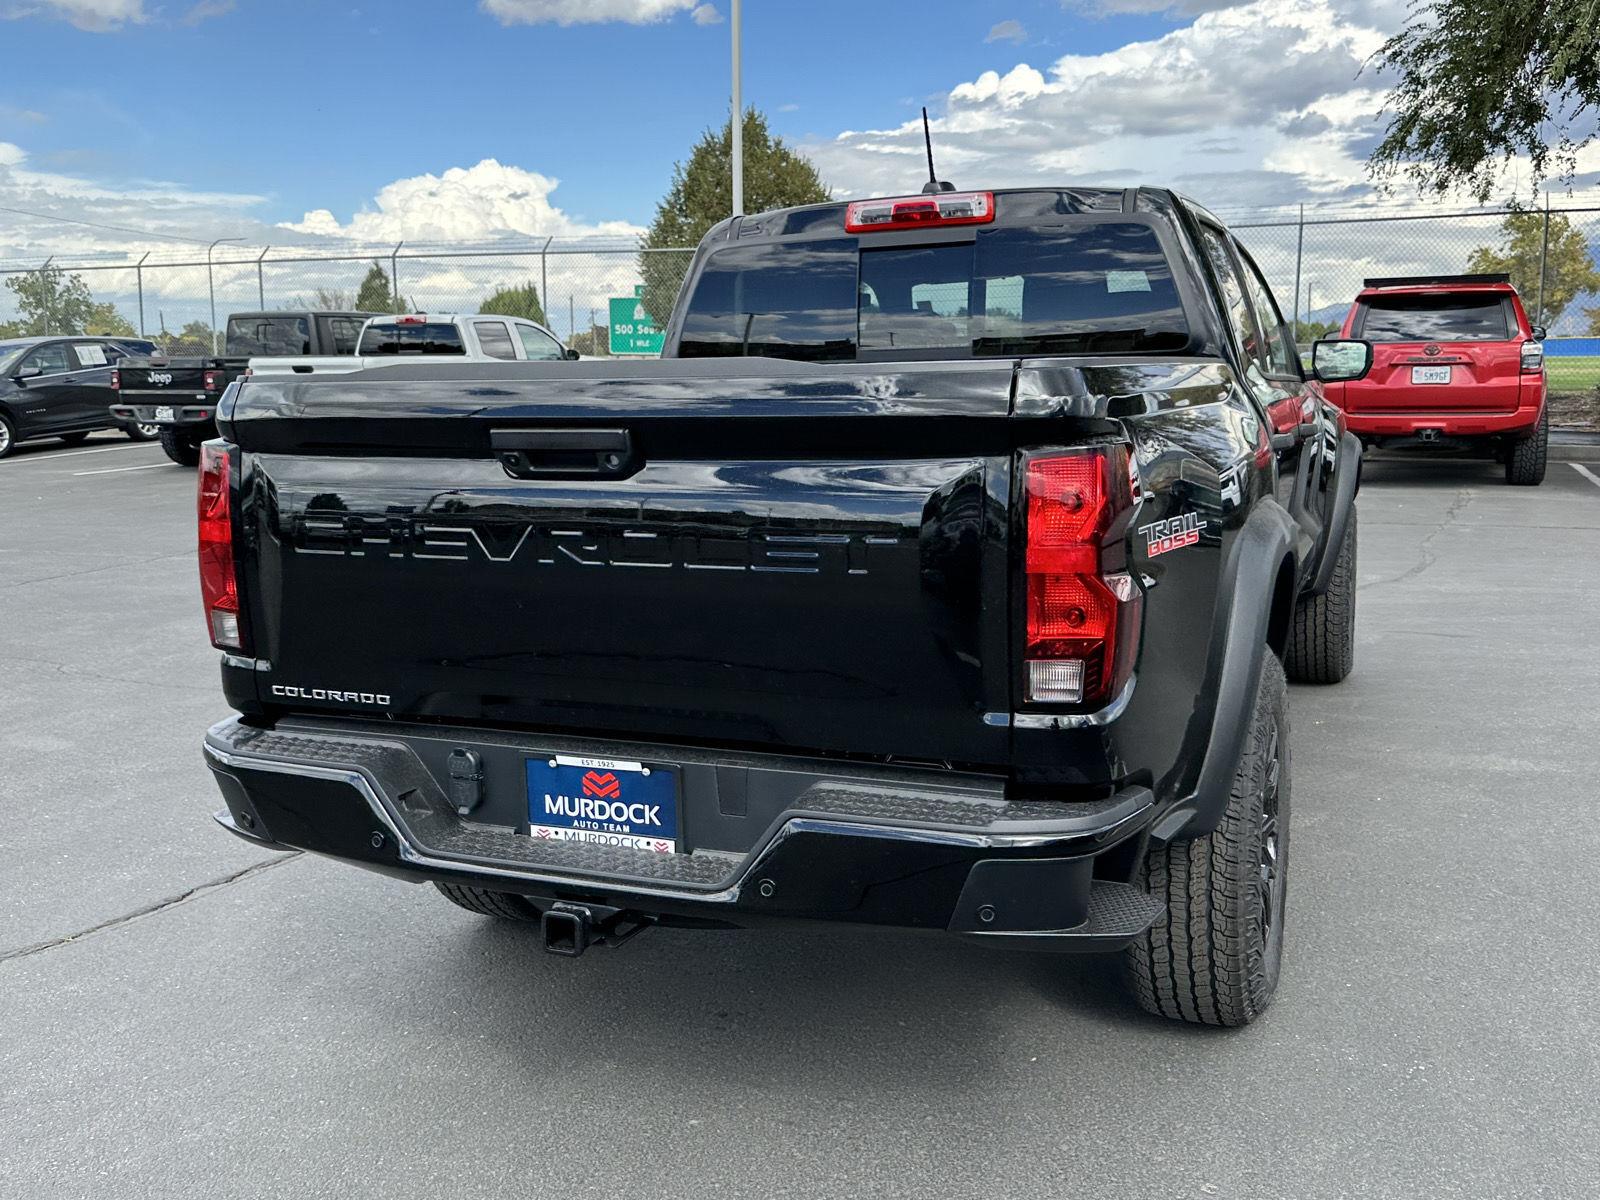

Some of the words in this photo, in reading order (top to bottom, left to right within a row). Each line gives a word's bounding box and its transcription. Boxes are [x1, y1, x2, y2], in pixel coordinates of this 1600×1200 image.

[615, 324, 633, 334] 500
[630, 339, 634, 348] 1
[147, 371, 173, 385] Jeep
[1138, 511, 1208, 544] TRAIL
[294, 515, 898, 576] CHEVROLET
[1147, 530, 1200, 558] BOSS
[271, 684, 391, 705] COLORADO
[597, 760, 616, 769] 1925
[544, 794, 662, 826] MURDOCK
[573, 819, 599, 830] AUTO
[603, 822, 630, 833] TEAM
[563, 830, 641, 849] MURDOCK
